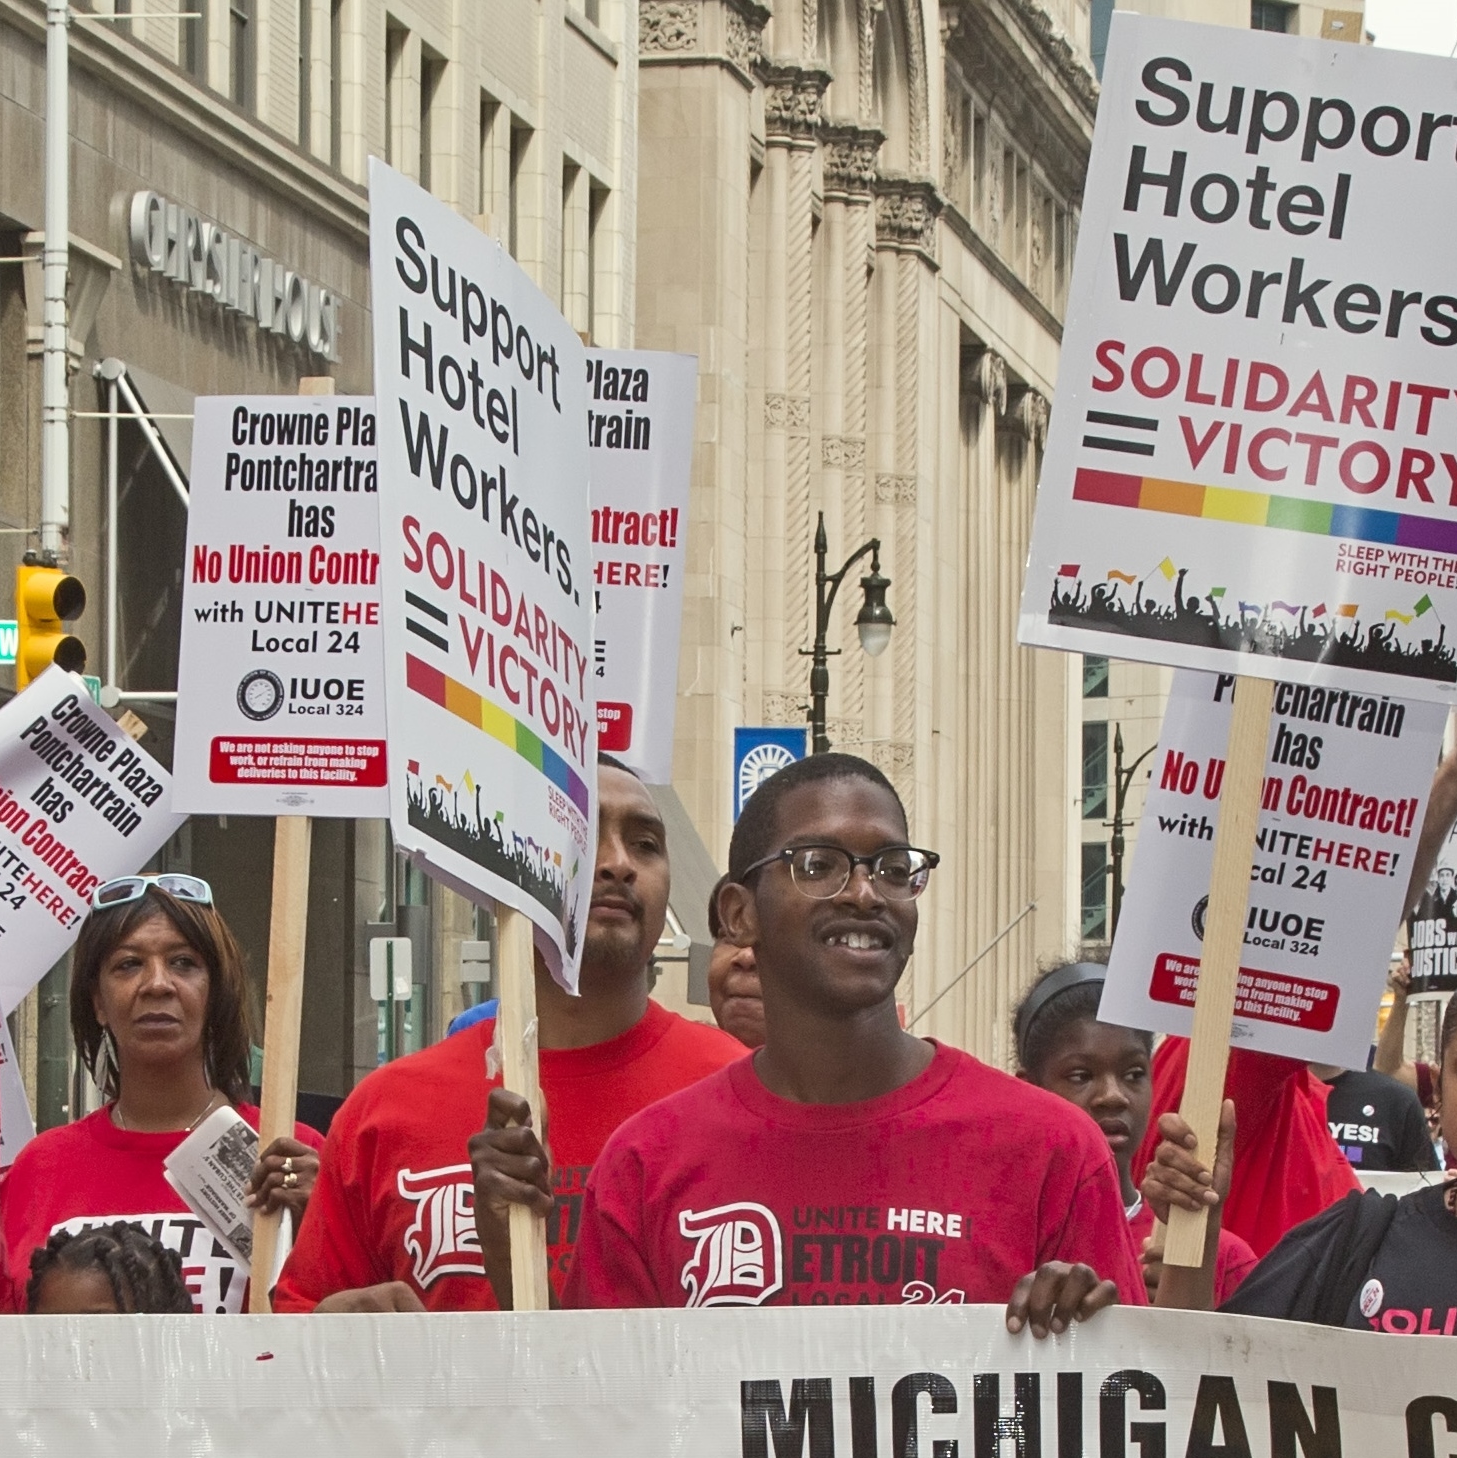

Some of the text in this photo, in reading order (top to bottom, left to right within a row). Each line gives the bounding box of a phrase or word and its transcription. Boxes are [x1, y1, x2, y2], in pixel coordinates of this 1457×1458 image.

[1123, 144, 1352, 239] Hotel
[395, 215, 561, 414] Support
[399, 306, 519, 456] Hotel
[232, 406, 328, 446] Crowne
[288, 498, 334, 538] has
[398, 398, 582, 605] Workers.
[192, 544, 302, 584] No Union
[1336, 559, 1390, 578] RIGHT
[1338, 544, 1384, 561] SLEEP
[1388, 550, 1428, 568] WITH
[194, 600, 243, 623] with
[402, 514, 588, 700] SOLIDARITY
[252, 630, 360, 653] Local 24
[290, 678, 365, 700] IUOE
[458, 614, 588, 769] VICTORY
[51, 694, 164, 808] Crowne Plaza
[20, 715, 142, 838] Pontchartrain
[1285, 775, 1419, 838] Contract!
[1247, 907, 1325, 942] IUOE
[1412, 918, 1447, 948] JOBS
[1329, 1122, 1379, 1144] YES!
[794, 1206, 880, 1228] UNITE
